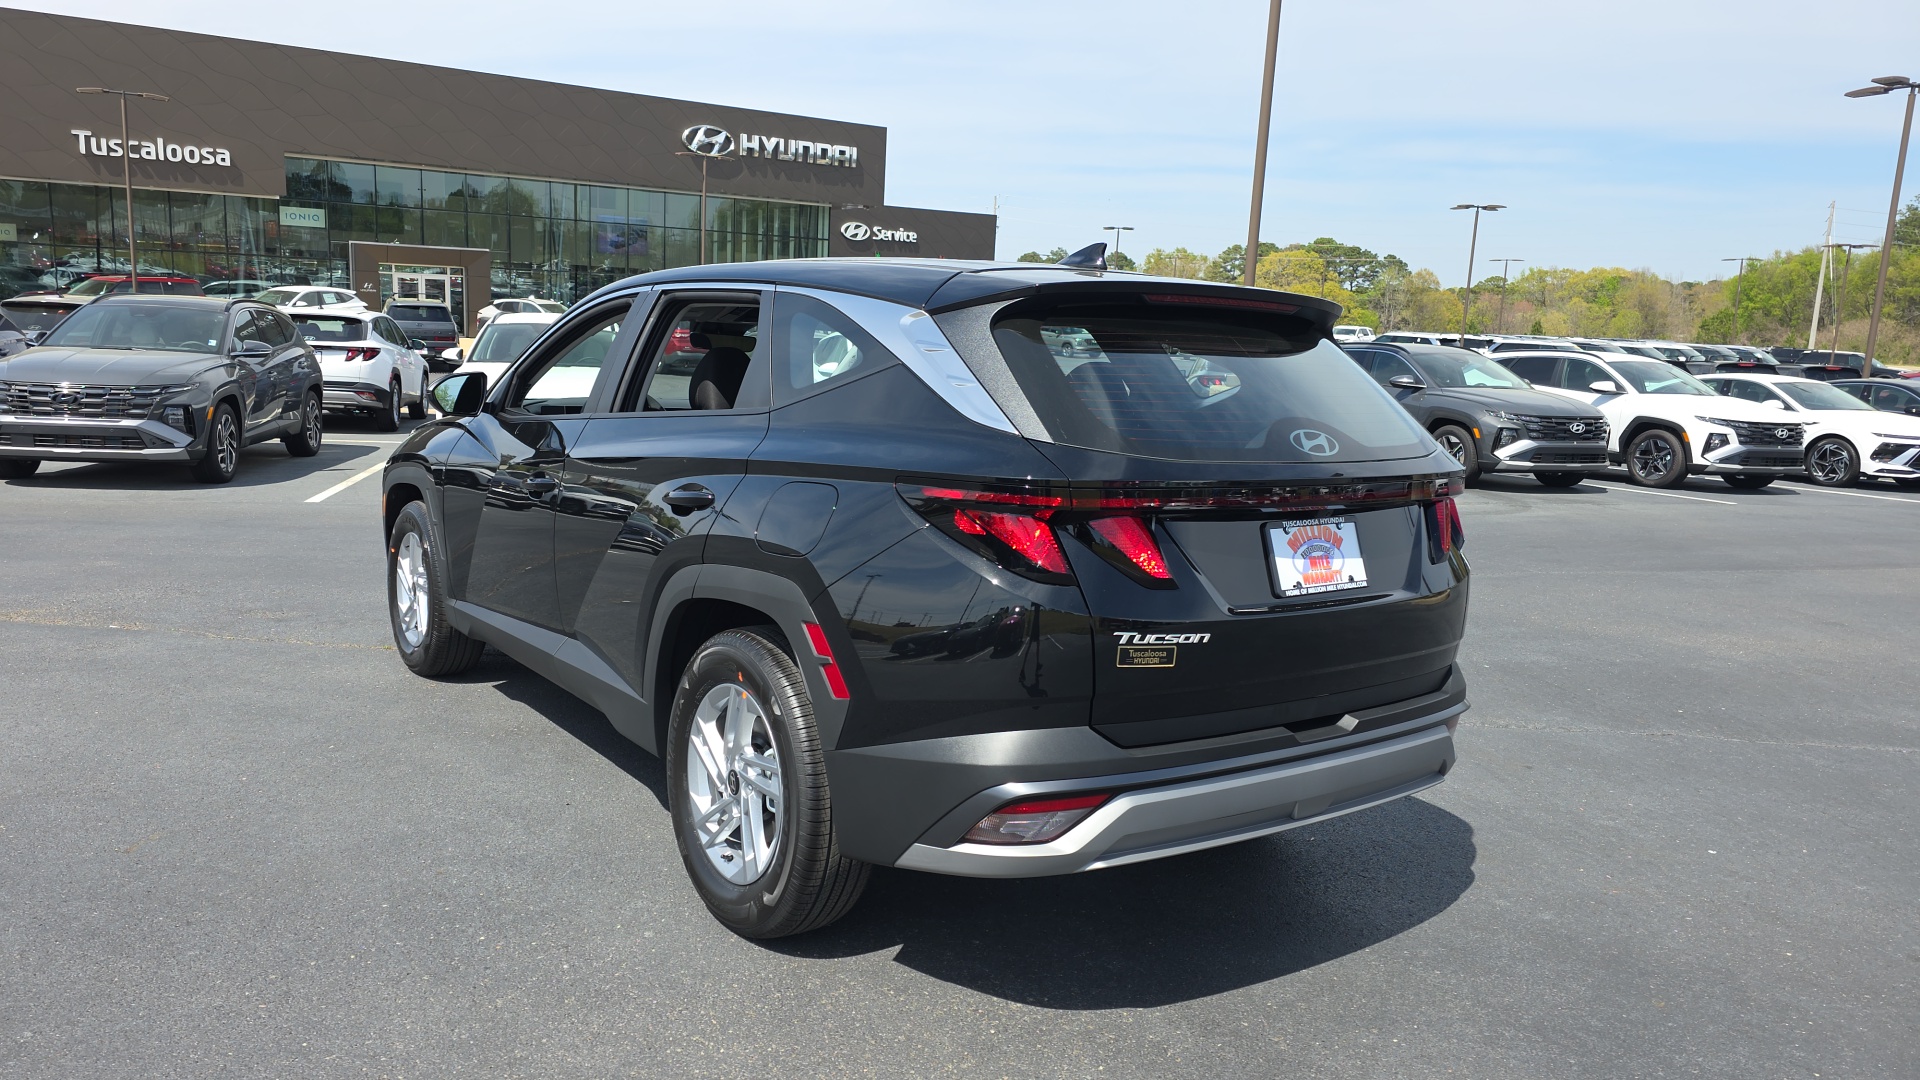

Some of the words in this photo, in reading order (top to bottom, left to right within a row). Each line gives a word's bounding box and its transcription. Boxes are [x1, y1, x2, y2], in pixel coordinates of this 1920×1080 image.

[70, 129, 231, 167] Tuscaloosa
[739, 133, 858, 168] HYUNDAI
[285, 212, 320, 222] IONIQ
[872, 226, 918, 243] Service
[1282, 519, 1319, 527] TUSCALOOSA
[1287, 525, 1344, 554] MILLION
[1308, 554, 1332, 571] MILE
[1302, 569, 1343, 585] WARRANTY
[1285, 589, 1301, 597] HOME
[1128, 649, 1167, 658] Tuscaloosa
